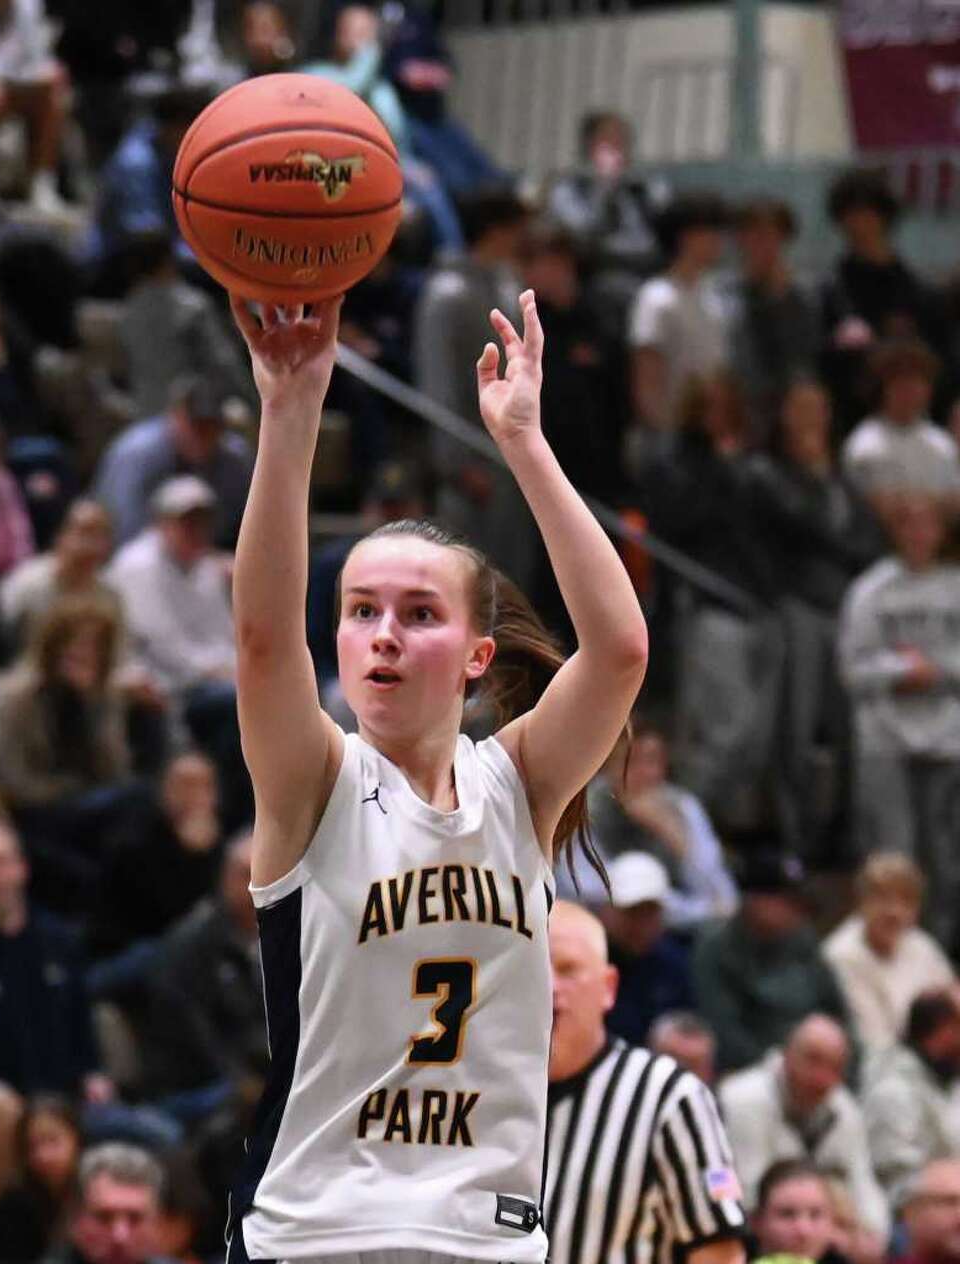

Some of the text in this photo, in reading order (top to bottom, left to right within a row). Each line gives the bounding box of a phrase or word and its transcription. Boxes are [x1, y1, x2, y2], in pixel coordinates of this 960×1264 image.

[357, 863, 534, 944] AVERILL
[404, 955, 480, 1069] 3
[357, 1087, 481, 1148] PARK
